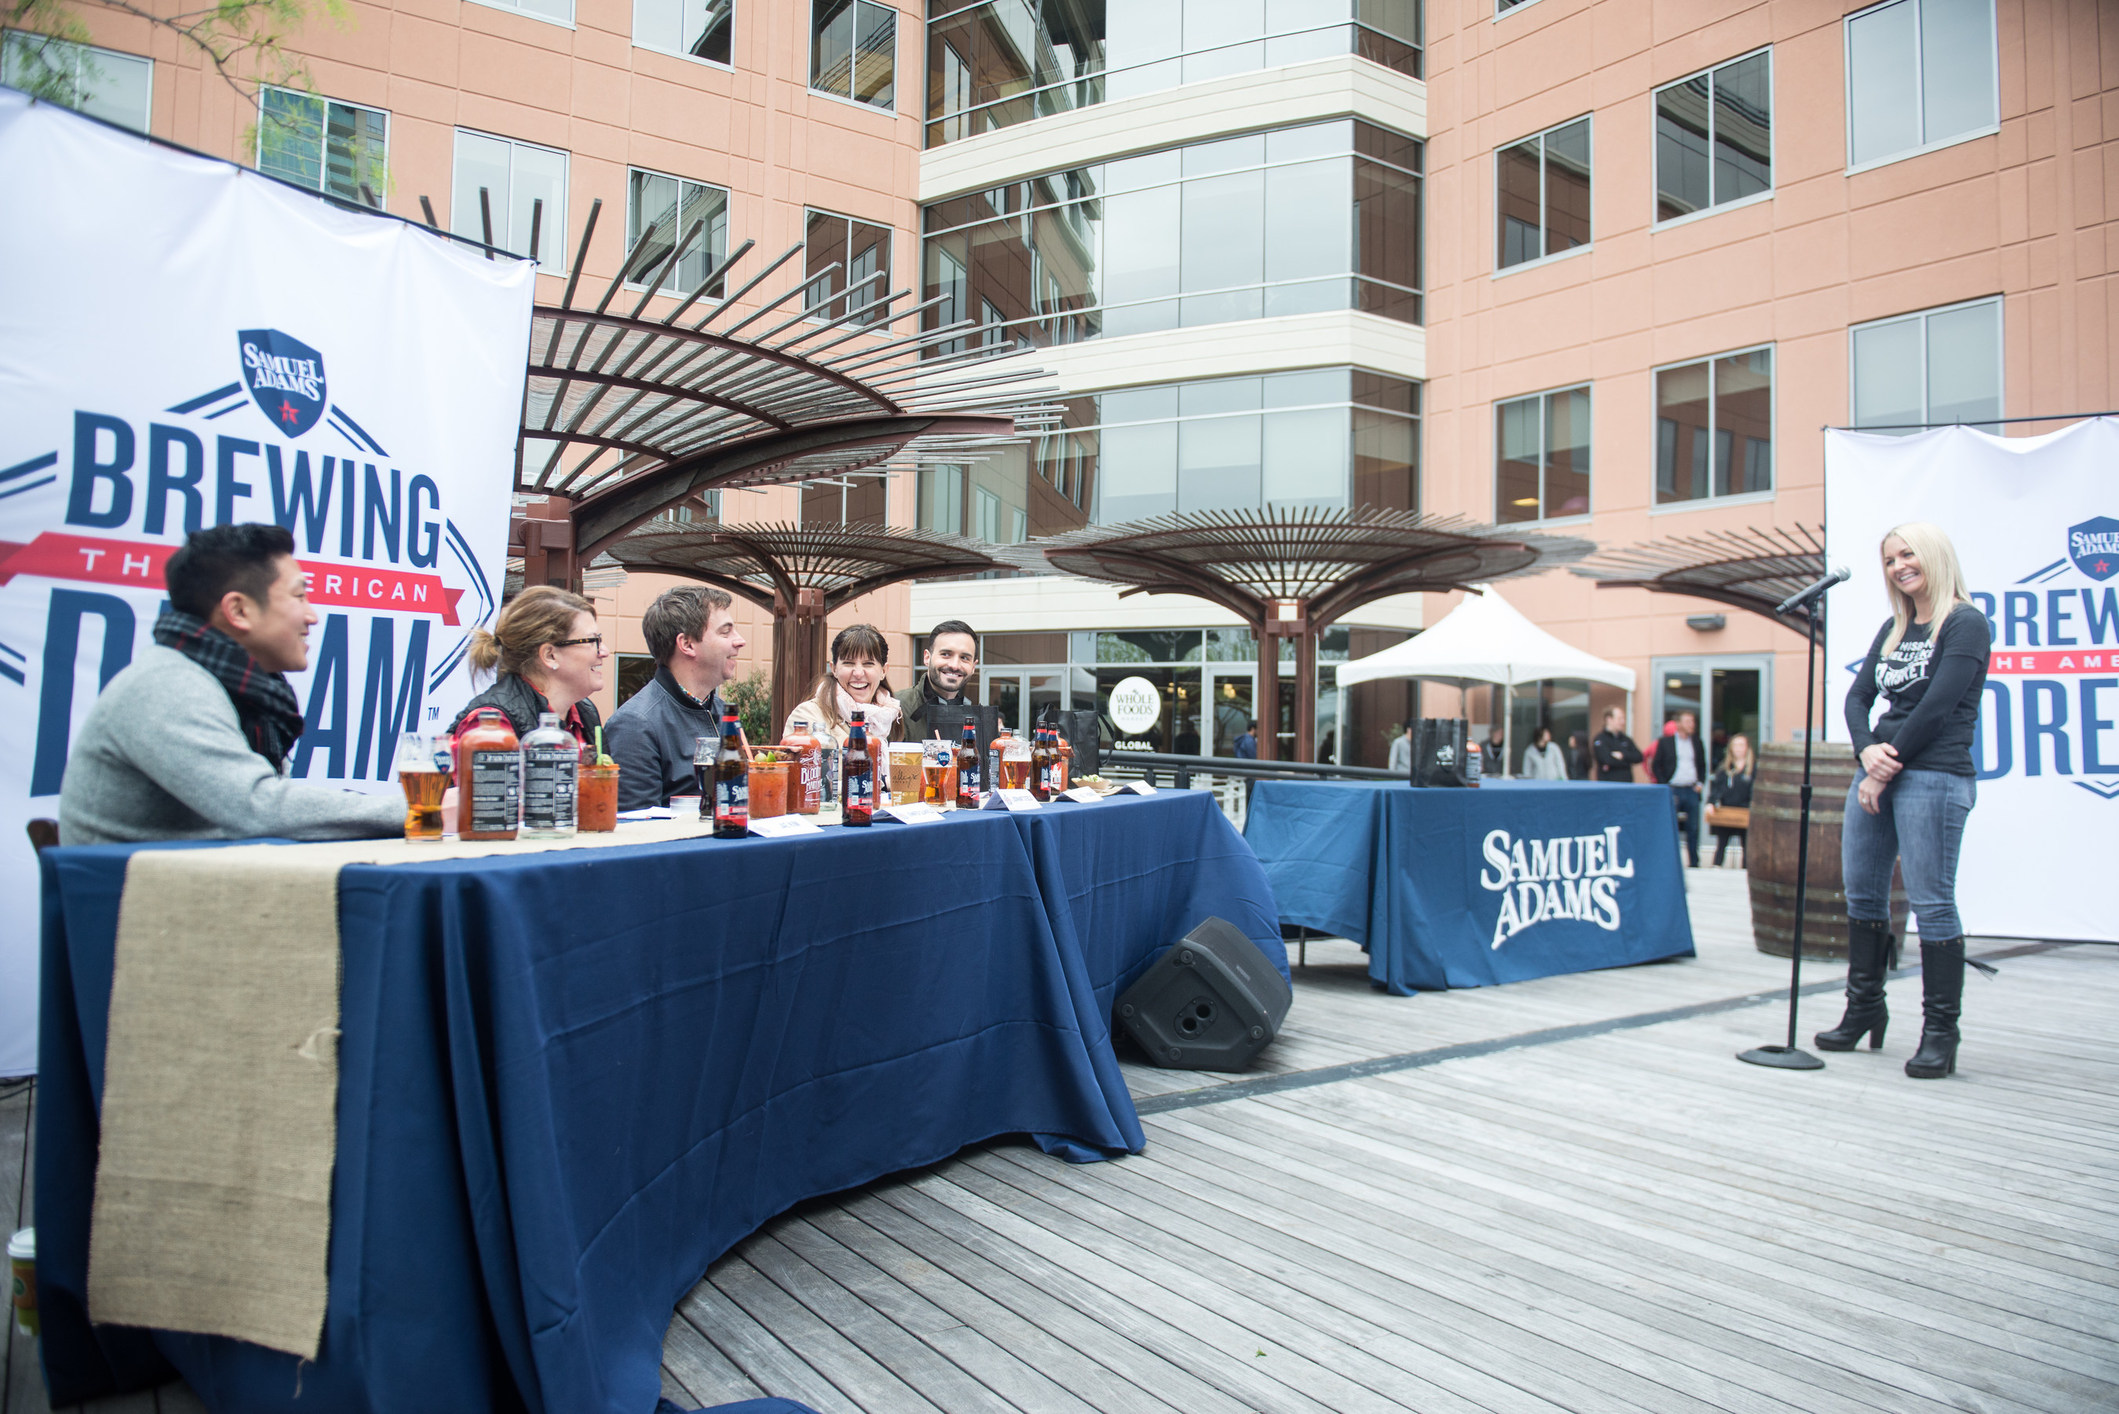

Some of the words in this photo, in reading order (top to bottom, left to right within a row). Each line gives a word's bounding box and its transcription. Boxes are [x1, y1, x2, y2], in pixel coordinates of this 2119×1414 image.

[243, 342, 324, 384] SAMUEL
[253, 367, 321, 402] ADAMS
[64, 409, 440, 569] BREWING
[2076, 541, 2119, 559] ADAM
[79, 548, 151, 577] TH
[301, 571, 428, 602] ERICAN
[1996, 656, 2036, 669] HE
[29, 587, 430, 797] DAM
[1116, 694, 1154, 704] WHOLE
[1118, 704, 1153, 715] FOODS
[1114, 741, 1154, 750] GLOBAL
[1481, 826, 1635, 891] SAMUEL
[1491, 876, 1620, 950] ADAMS
